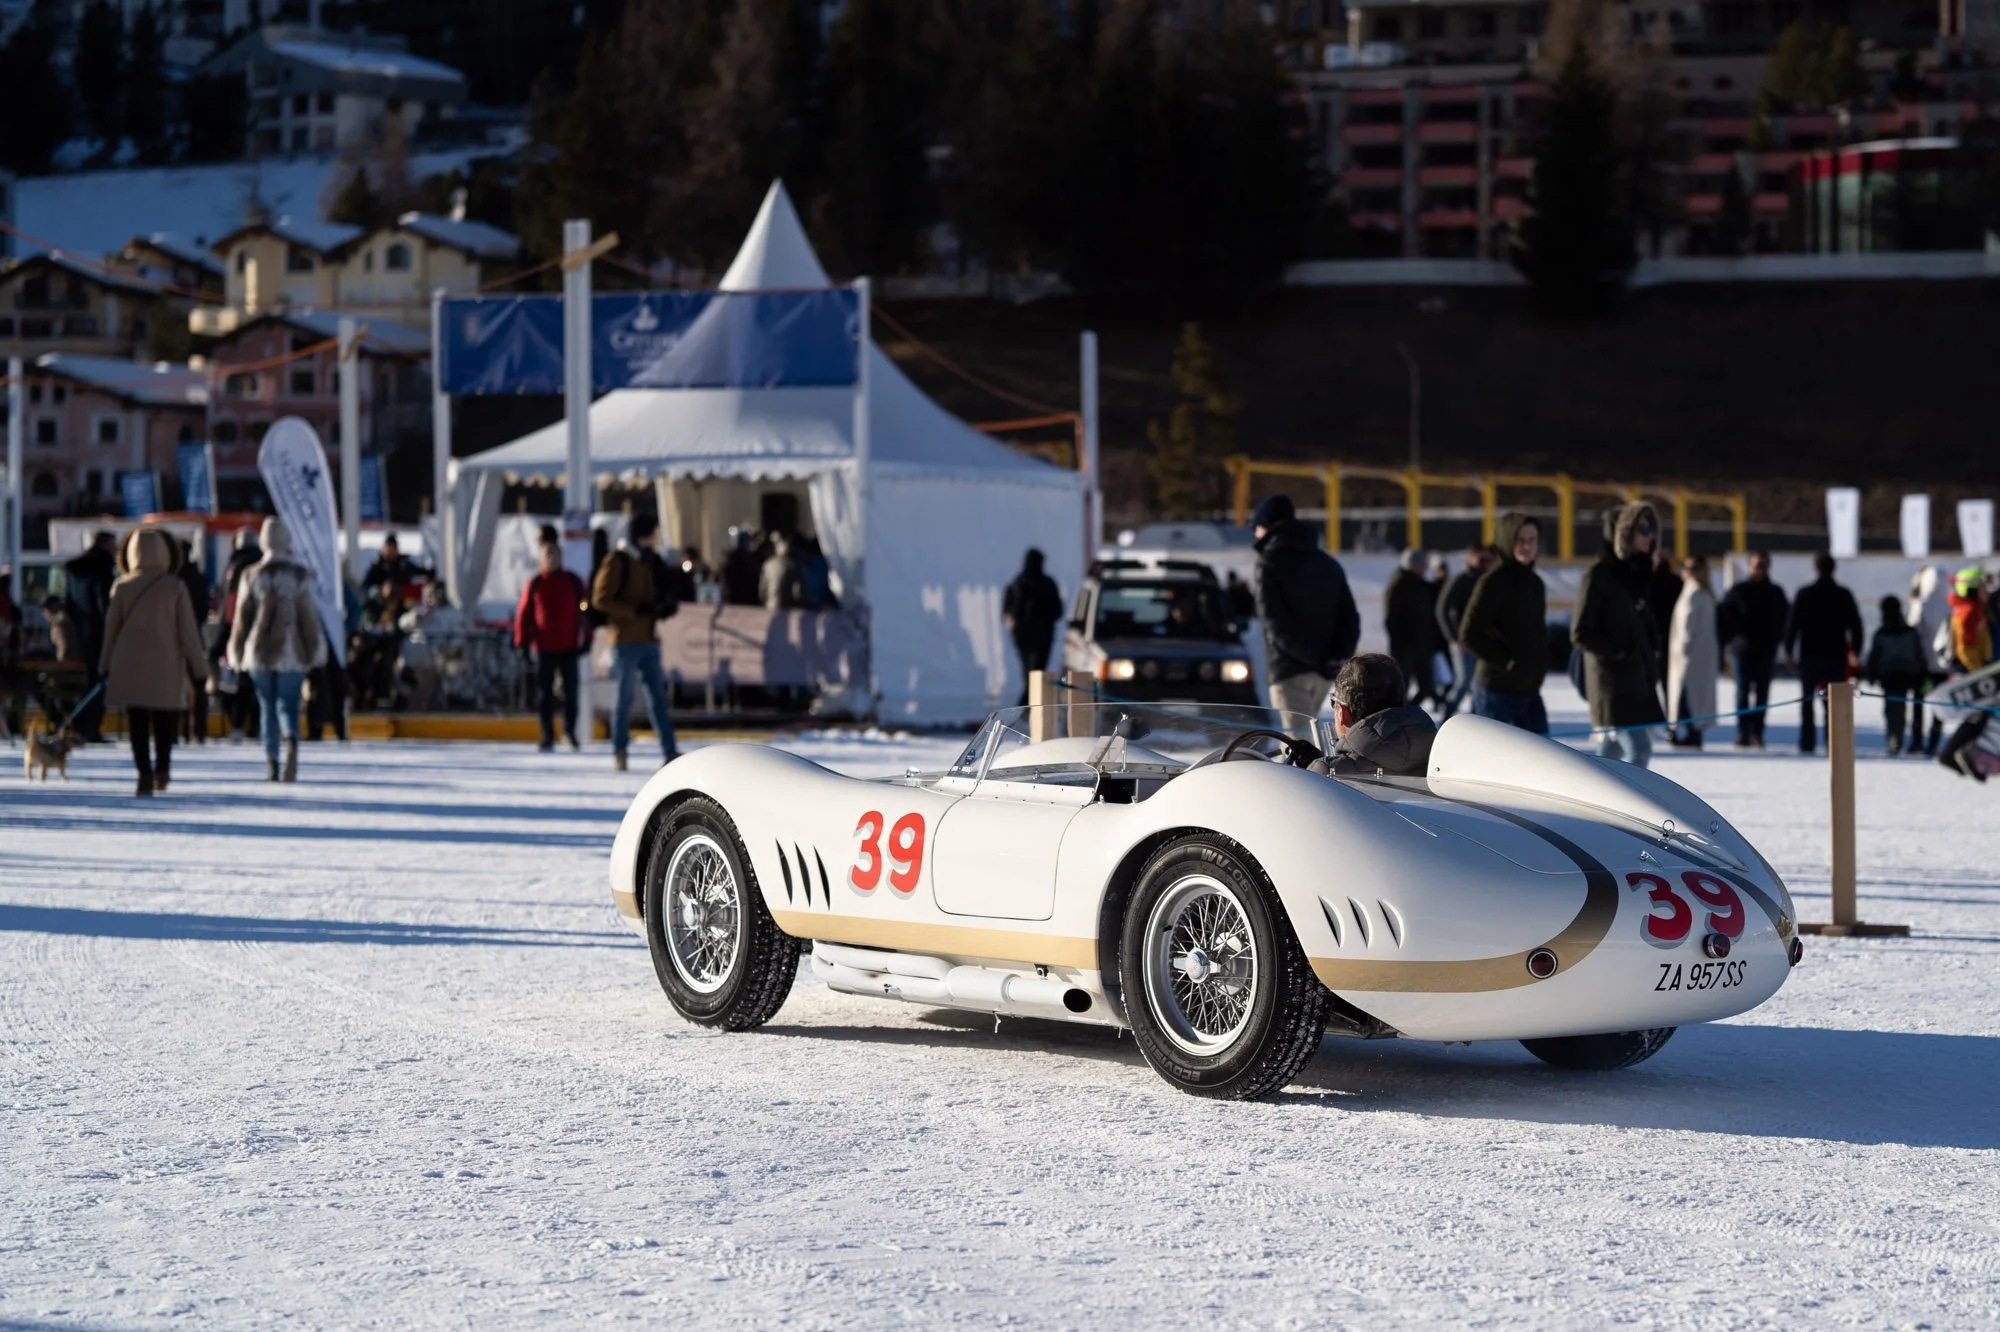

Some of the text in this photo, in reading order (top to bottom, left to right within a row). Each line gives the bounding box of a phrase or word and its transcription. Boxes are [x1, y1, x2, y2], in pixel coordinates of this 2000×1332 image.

[851, 809, 926, 896] 39
[1201, 848, 1252, 892] WV-06
[1625, 871, 1745, 944] 39
[1654, 960, 1747, 991] ZA 957SS
